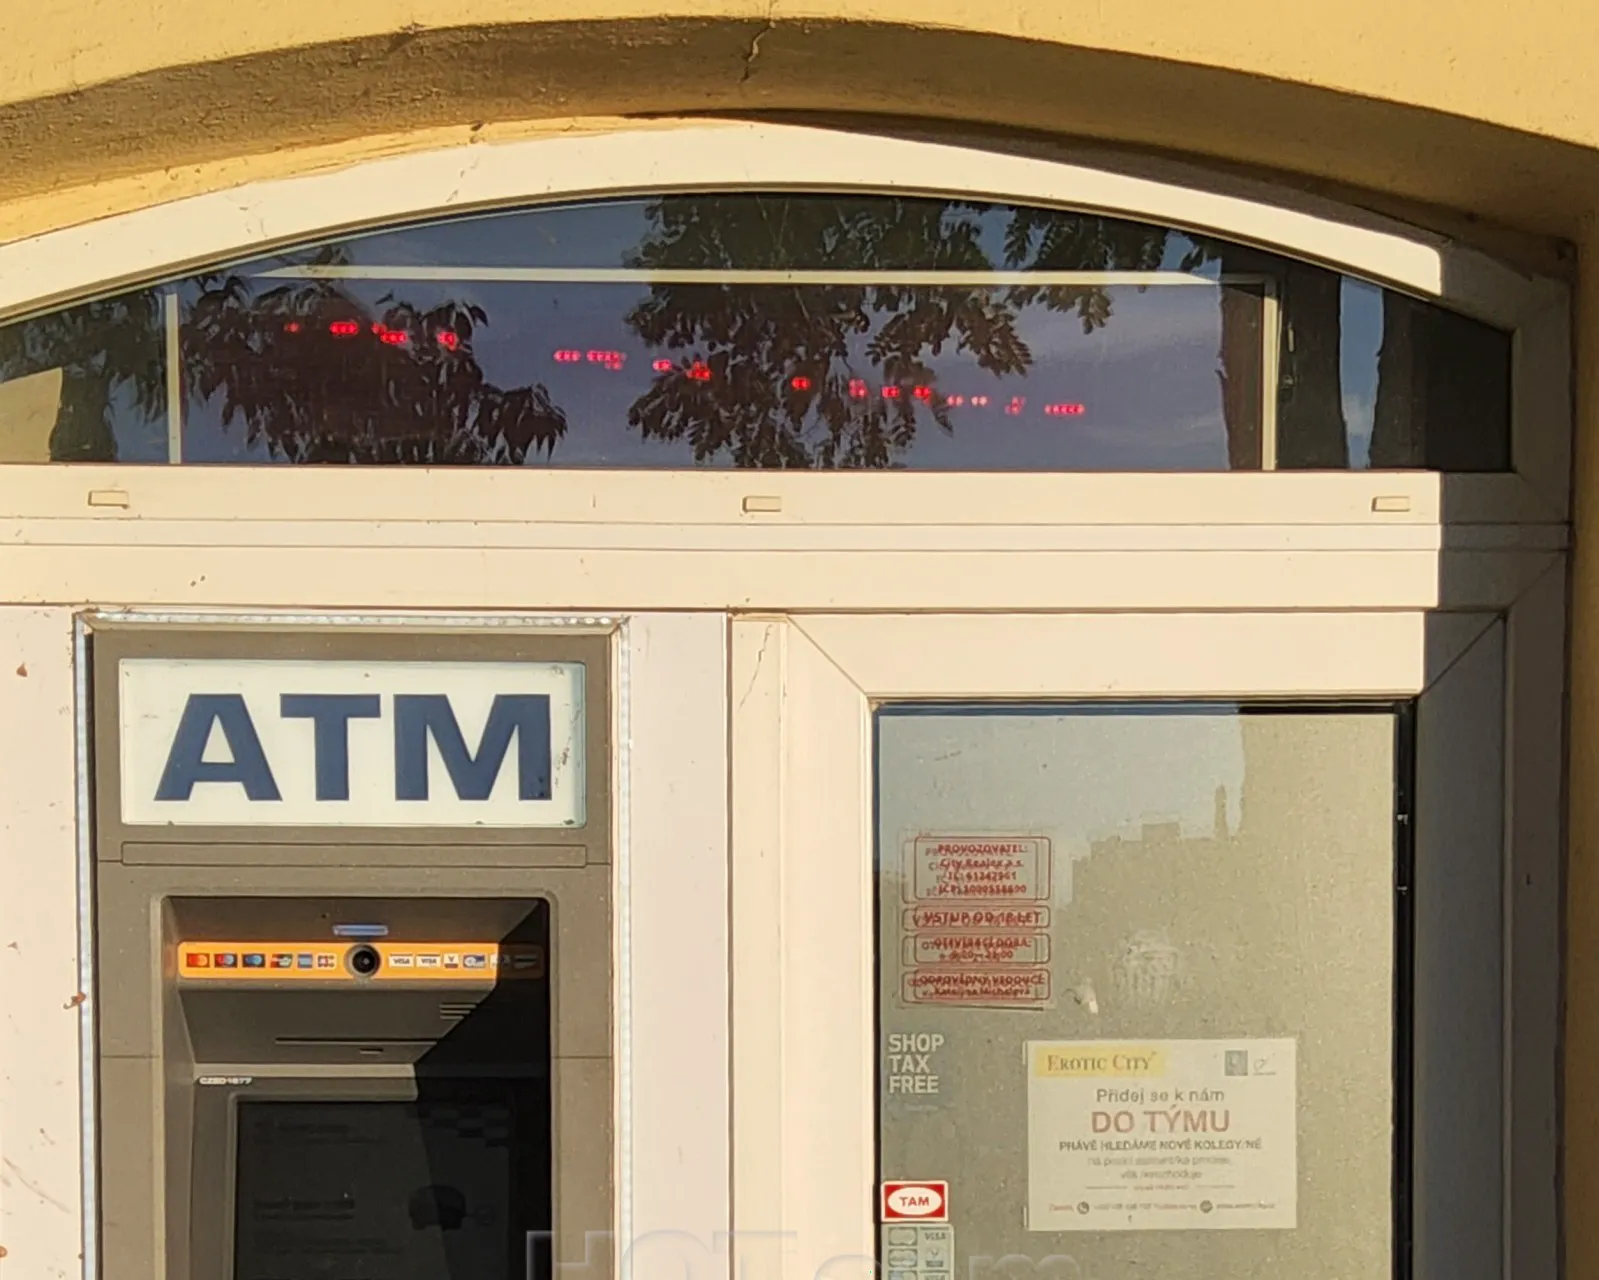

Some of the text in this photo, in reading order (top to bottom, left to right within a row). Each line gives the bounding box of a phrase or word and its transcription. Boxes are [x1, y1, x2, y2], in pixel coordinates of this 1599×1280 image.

[154, 693, 552, 801] ATM
[924, 911, 970, 923] VSTUP
[973, 911, 994, 923] OD
[1018, 911, 1042, 923] LET
[888, 1034, 944, 1053] SHOP
[888, 1055, 930, 1073] TAX
[889, 1076, 939, 1094] FREE
[1096, 1087, 1144, 1105] Přidej
[1175, 1088, 1184, 1102] k
[1189, 1088, 1225, 1102] nám
[1091, 1104, 1230, 1134] DO TÝMU
[899, 1196, 930, 1207] TAM
